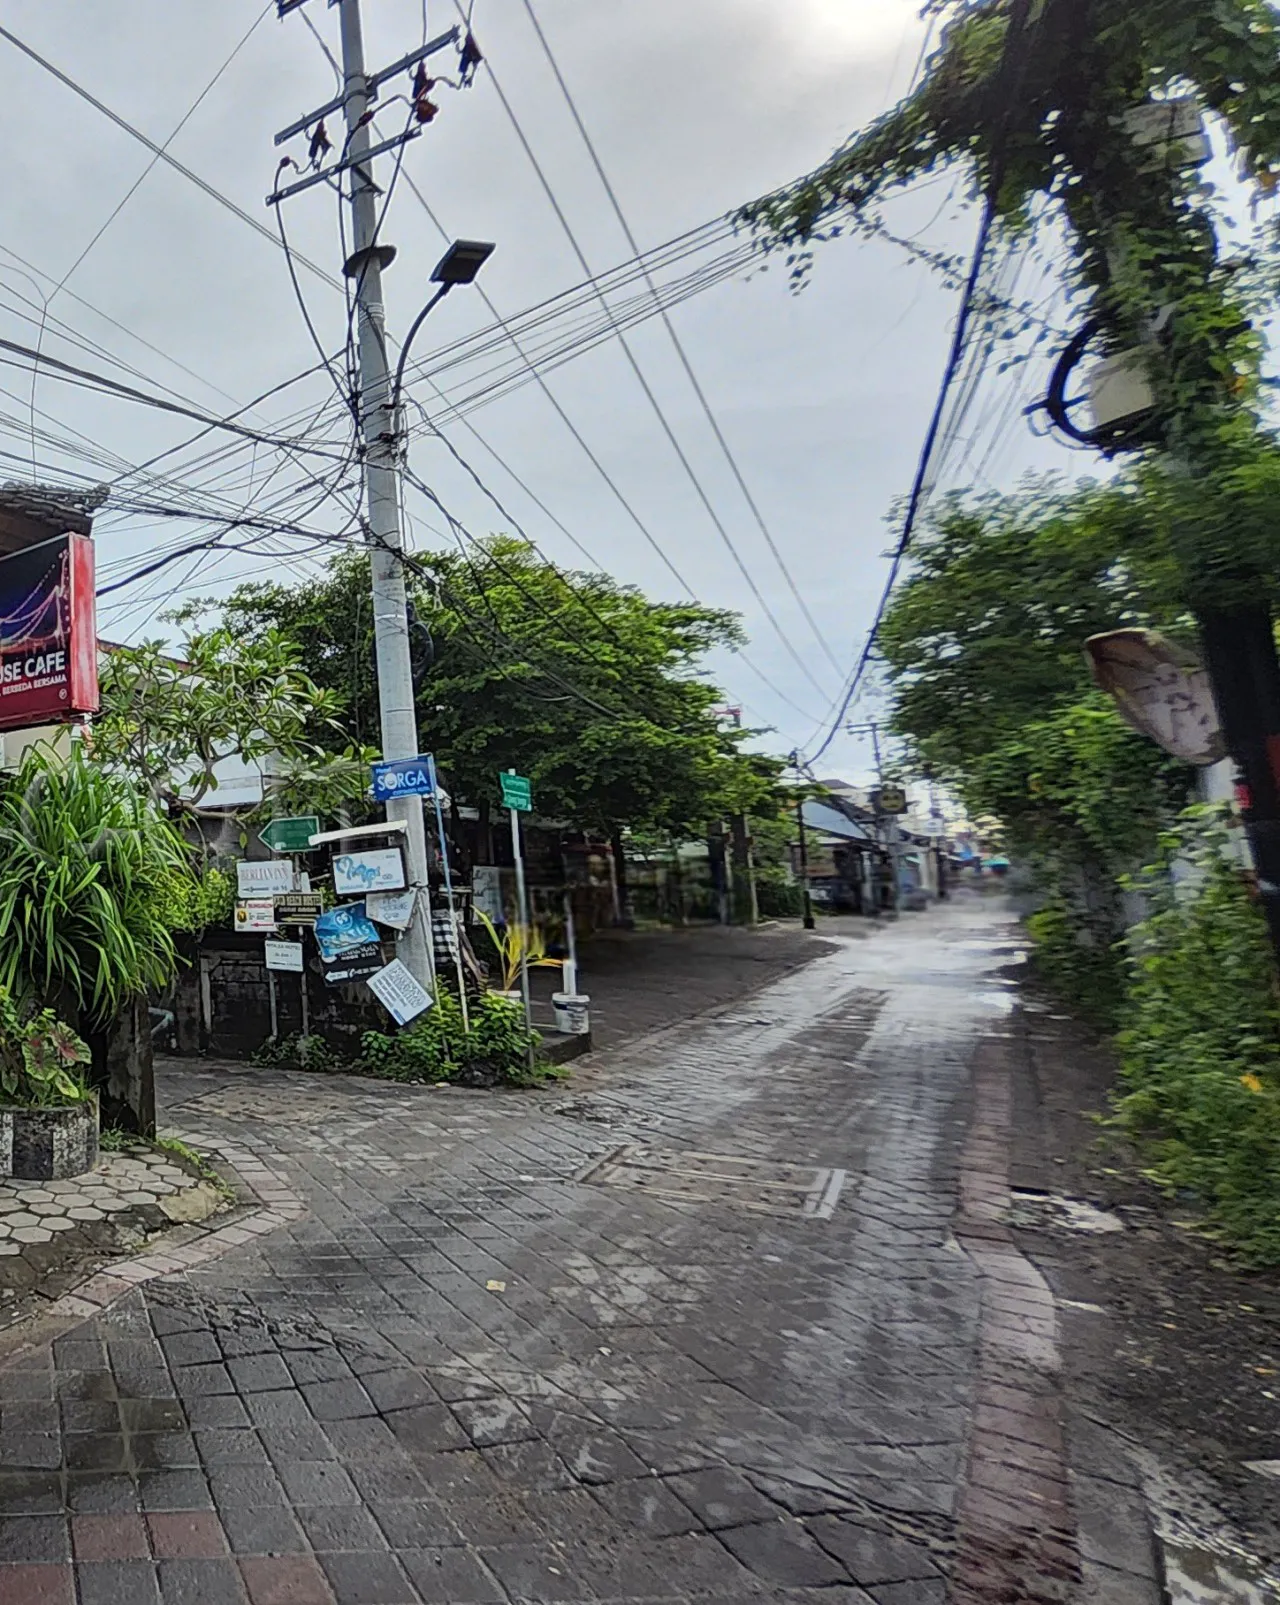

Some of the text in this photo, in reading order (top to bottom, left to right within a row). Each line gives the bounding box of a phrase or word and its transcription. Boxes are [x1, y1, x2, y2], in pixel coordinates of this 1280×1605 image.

[24, 650, 65, 678] CAFE
[33, 674, 68, 689] BERSAMA
[377, 769, 428, 792] SORGA
